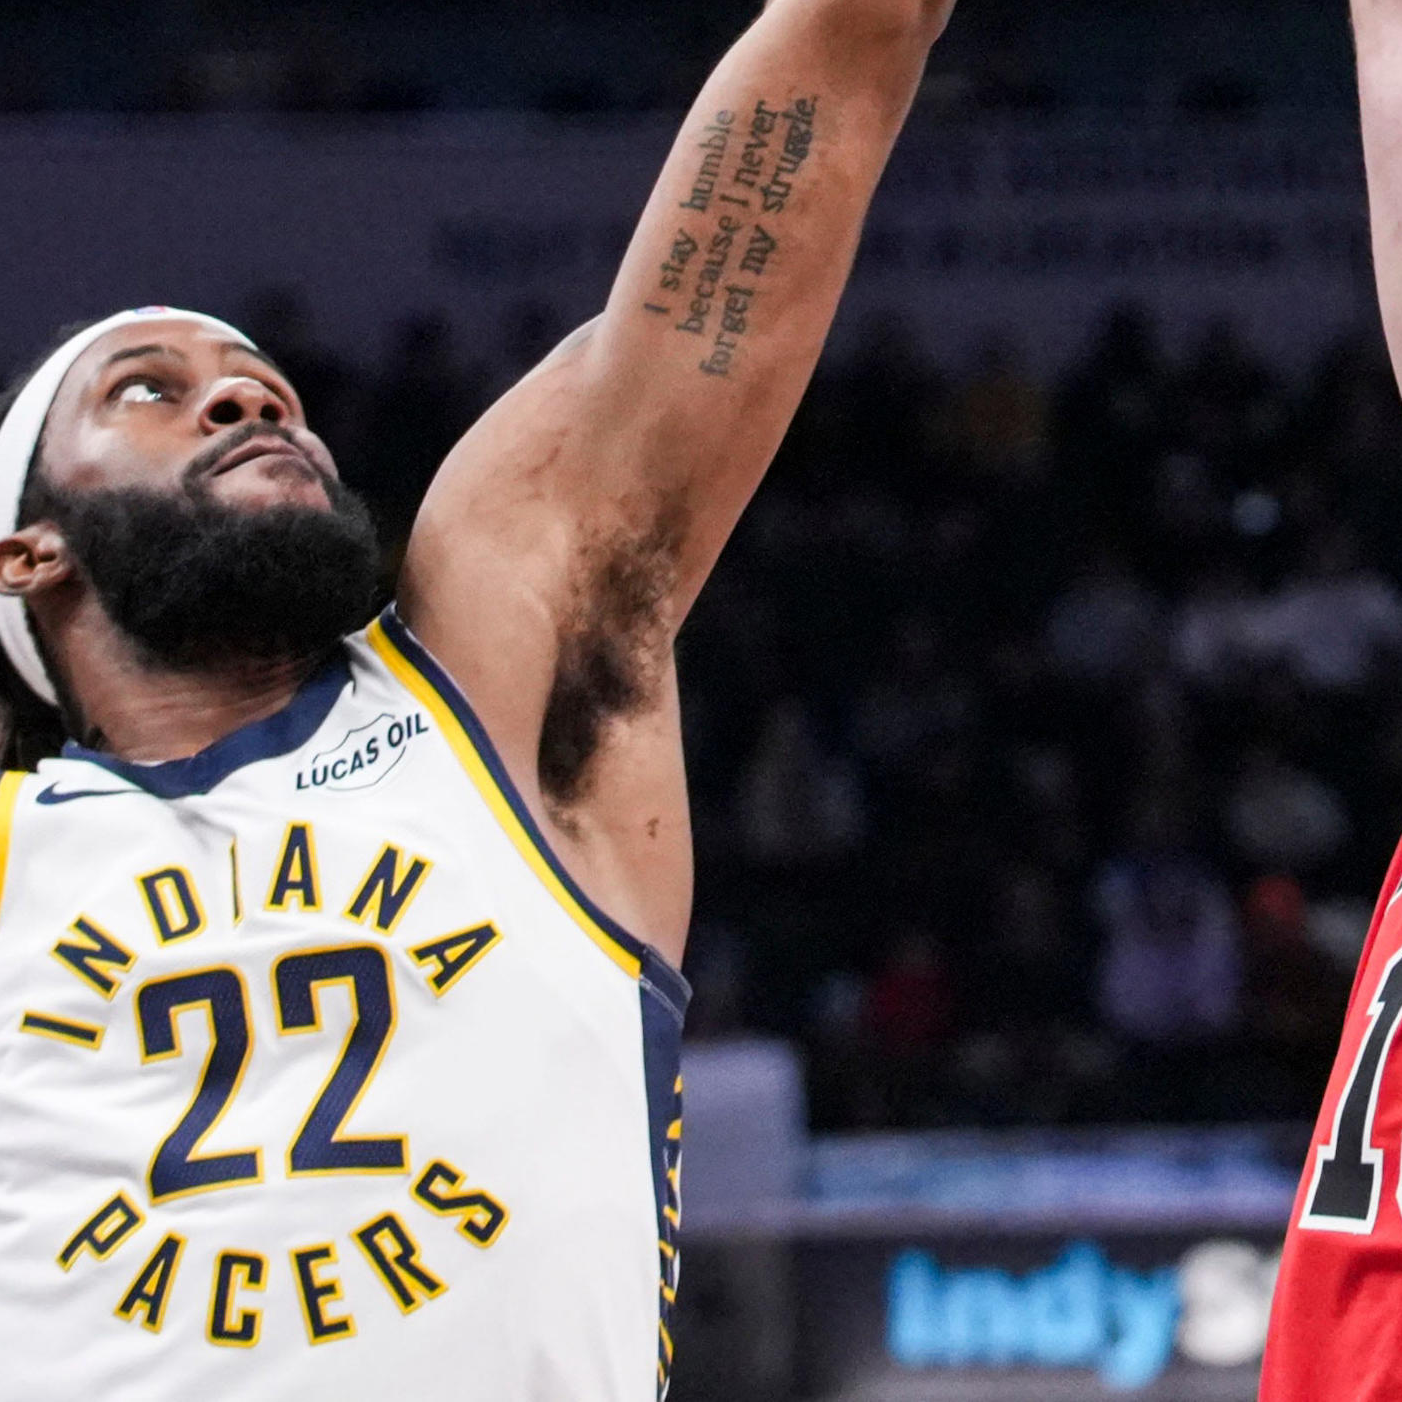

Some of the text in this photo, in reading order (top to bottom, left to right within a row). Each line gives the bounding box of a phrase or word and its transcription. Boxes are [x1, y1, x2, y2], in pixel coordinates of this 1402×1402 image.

[644, 108, 736, 315] I stay humble
[675, 99, 778, 335] because I never
[699, 285, 754, 378] forget
[739, 224, 778, 276] my
[296, 712, 430, 791] LUCAS OIL
[133, 940, 410, 1208] 22
[55, 1157, 511, 1349] PACERS
